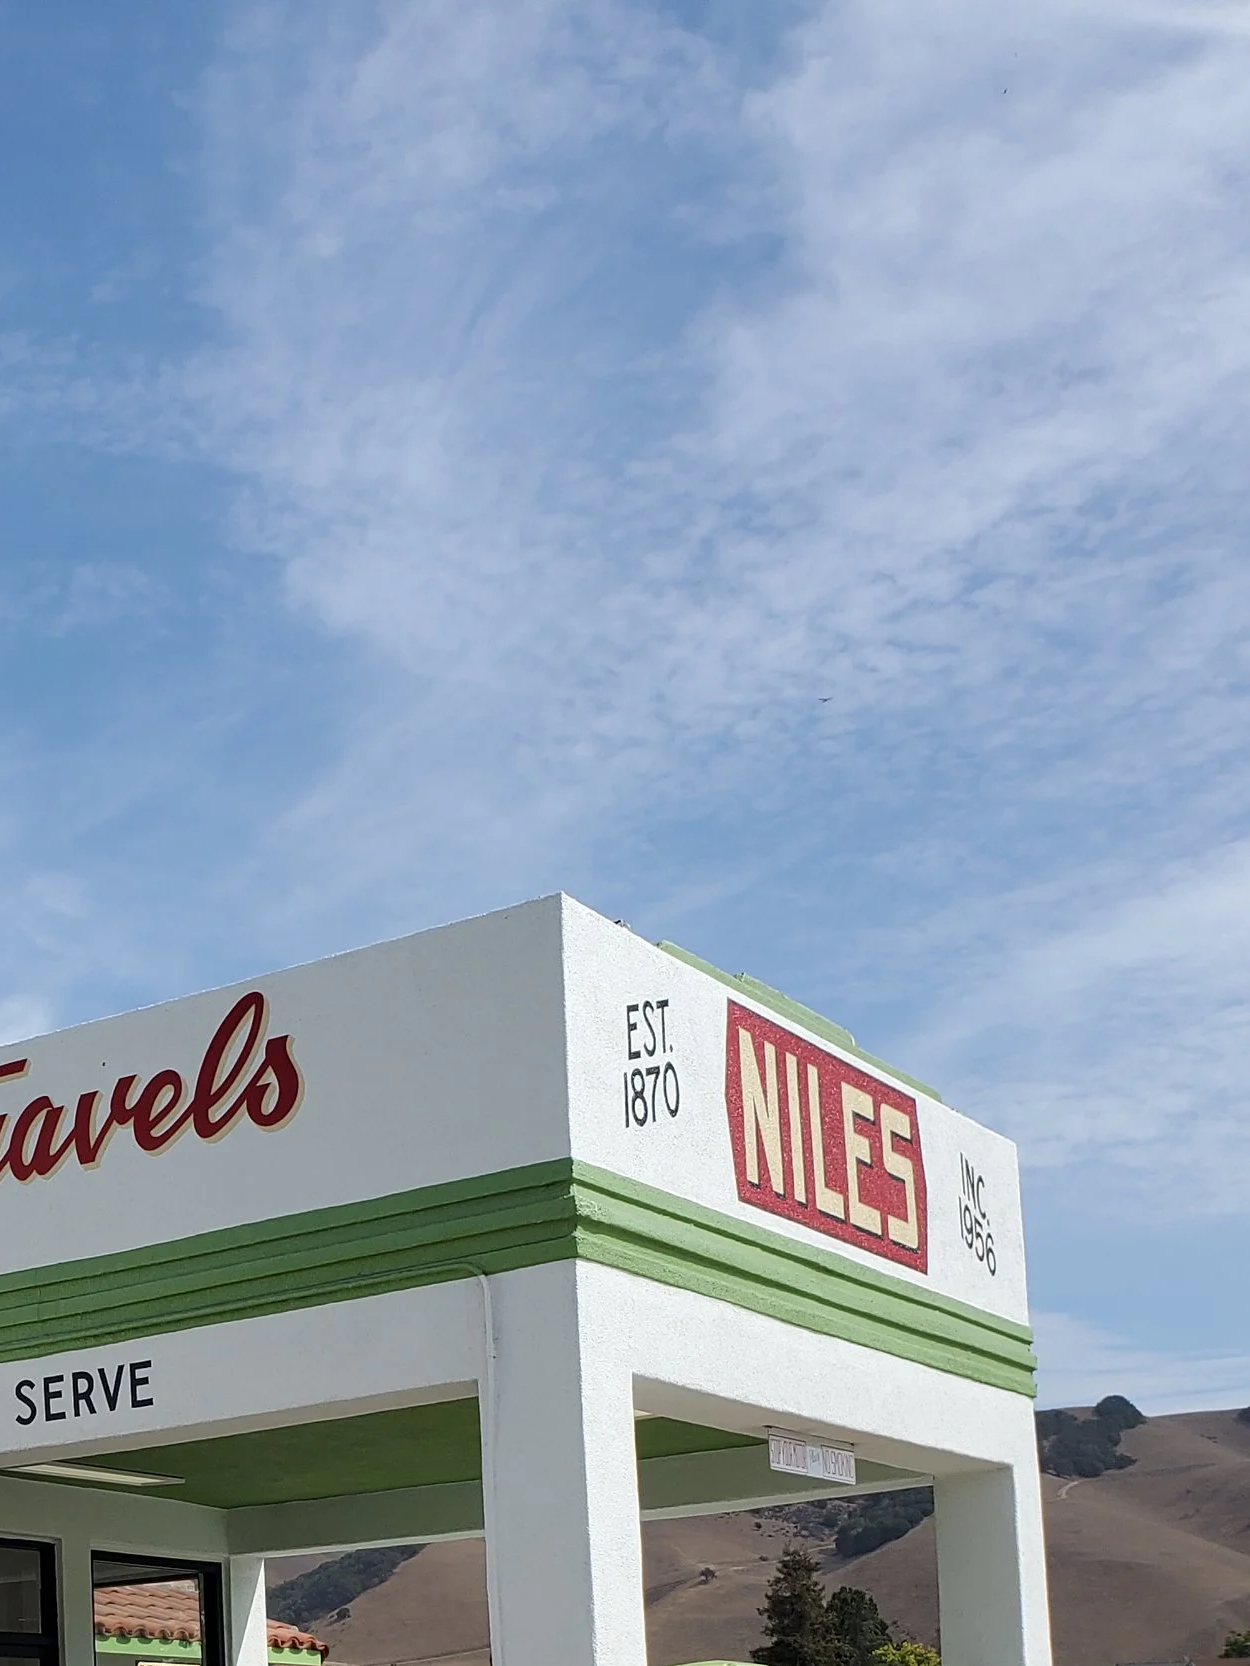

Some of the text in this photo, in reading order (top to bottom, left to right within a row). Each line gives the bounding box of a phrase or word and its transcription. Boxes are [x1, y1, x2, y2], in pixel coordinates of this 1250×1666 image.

[626, 998, 674, 1061] EST.
[623, 1060, 680, 1129] 1870
[738, 1025, 919, 1255] NILES
[959, 1151, 990, 1228] INC.
[958, 1196, 997, 1277] 1956
[14, 1360, 154, 1426] SERVE
